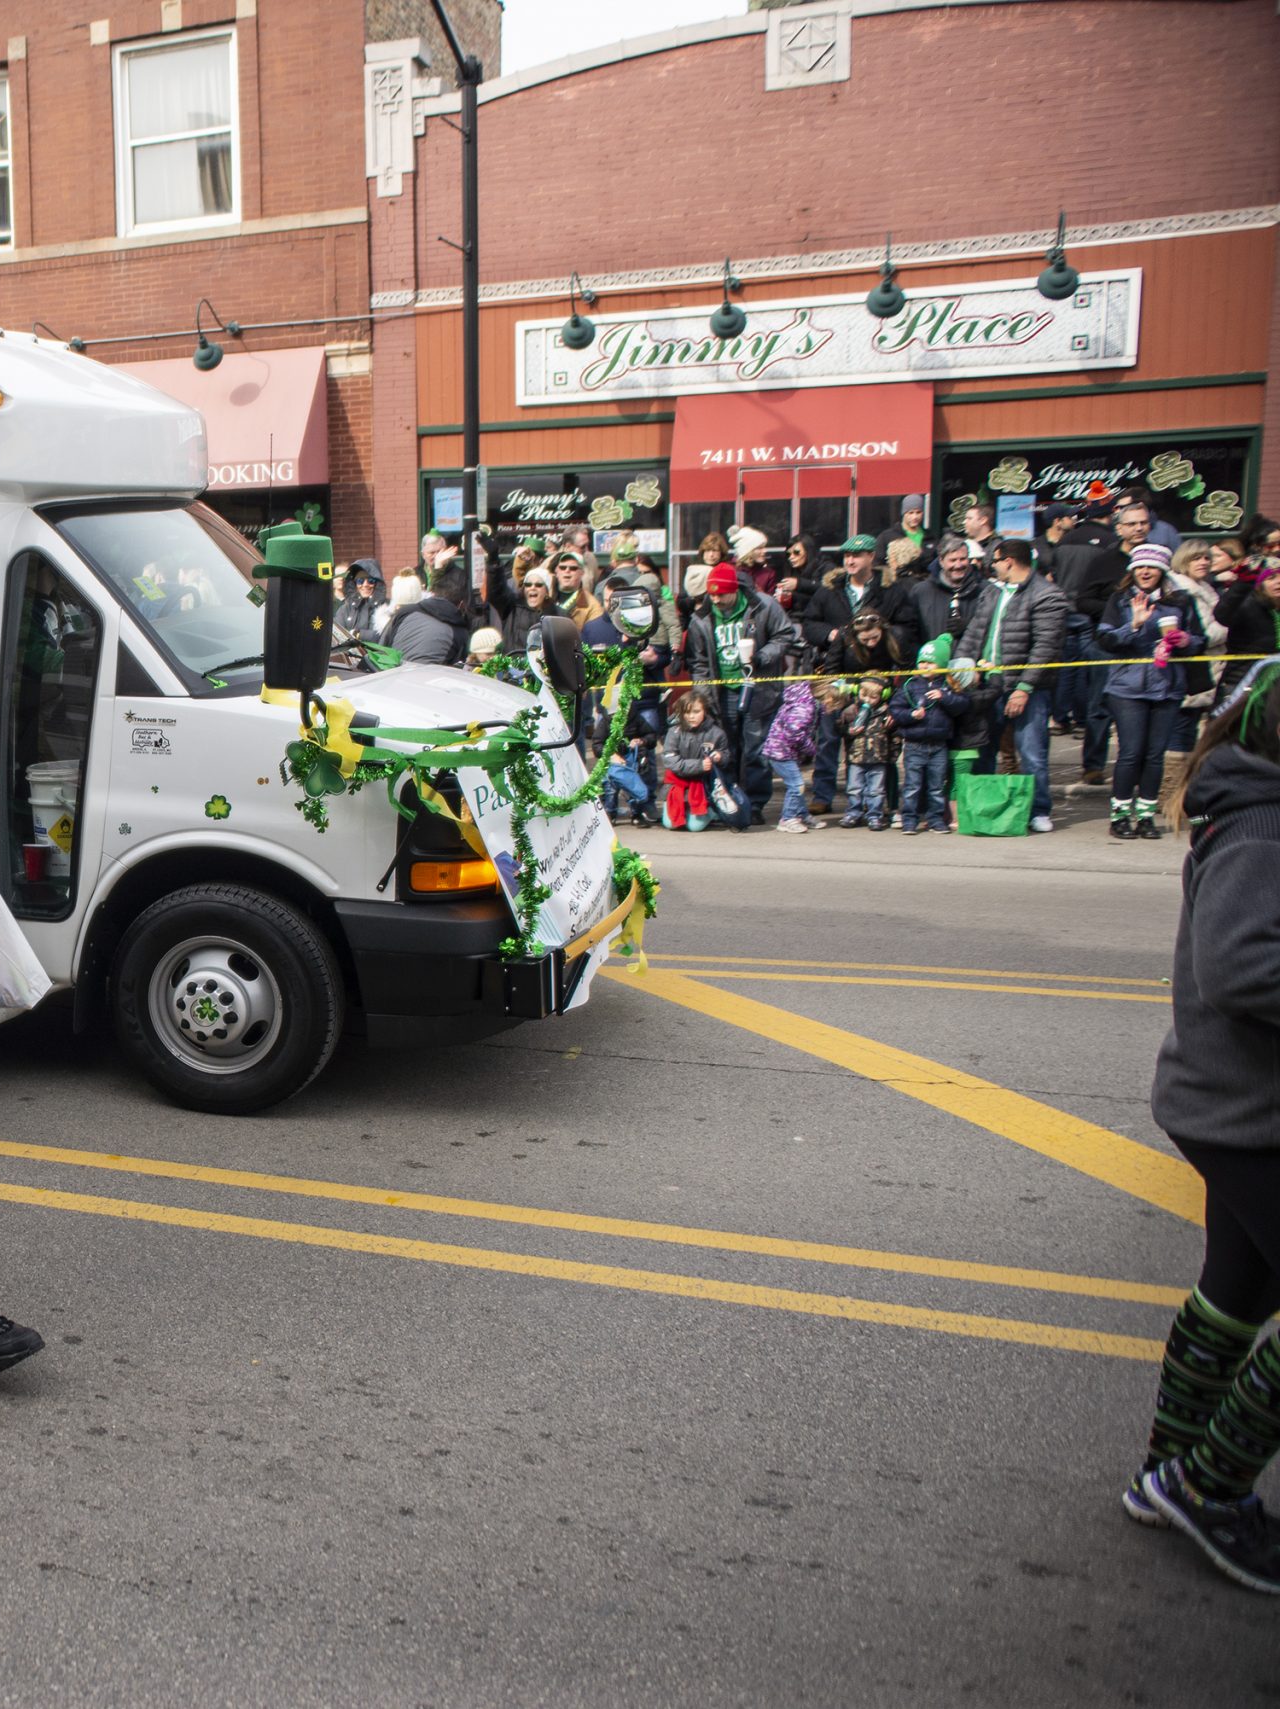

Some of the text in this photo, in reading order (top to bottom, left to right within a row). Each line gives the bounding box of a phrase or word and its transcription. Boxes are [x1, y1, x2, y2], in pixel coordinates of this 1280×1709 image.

[582, 297, 1052, 389] Jimmy's Place
[699, 440, 899, 466] 7411 W. MADISON
[208, 461, 293, 485] OOKING
[1029, 460, 1147, 491] Jimmy's
[500, 488, 587, 512] Jimmy's
[1052, 480, 1127, 500] Ple
[518, 507, 574, 521] Place
